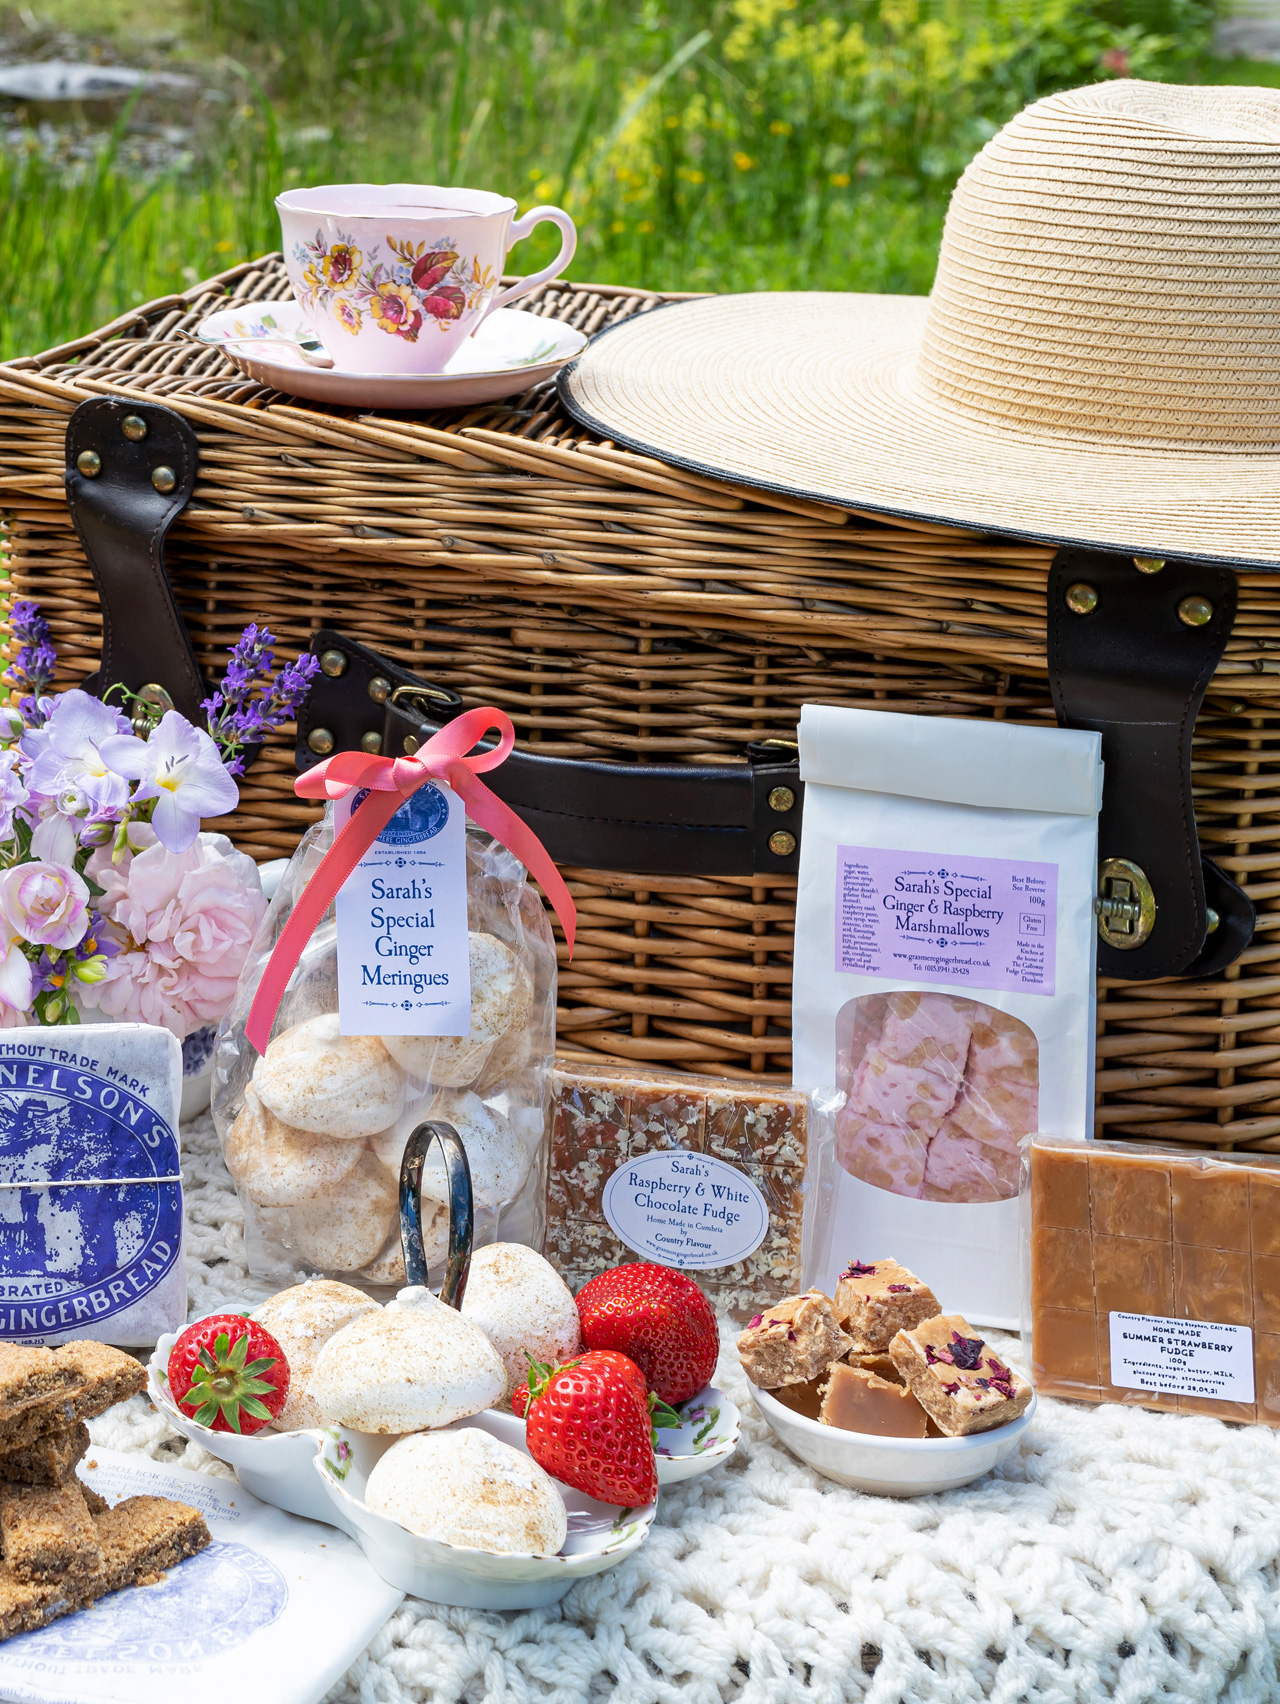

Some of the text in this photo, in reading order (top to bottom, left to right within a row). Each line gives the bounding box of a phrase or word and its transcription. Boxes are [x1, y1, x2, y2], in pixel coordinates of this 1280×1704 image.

[1012, 875, 1046, 885] Best Before:
[371, 878, 432, 900] Sarah's
[894, 876, 992, 902] Sarah's Special
[1025, 885, 1046, 893] Reverse
[1029, 896, 1045, 907] 100g
[883, 895, 1004, 924] Ginger & Raspberry
[371, 907, 435, 935] Special
[1023, 915, 1042, 924] Gluten
[895, 915, 990, 938] Marshmallows
[1026, 924, 1038, 932] Free
[375, 936, 434, 965] Ginger
[893, 953, 990, 967] www.grasmeregingerbread.co.uk
[1022, 962, 1044, 971] Galloway
[951, 967, 970, 975] 35428
[1006, 967, 1043, 978] Fudge Company
[361, 965, 449, 994] Meringues
[50, 1048, 99, 1071] TRADE
[106, 1066, 150, 1097] MARK
[671, 1160, 709, 1177] Sarah's
[628, 1172, 750, 1203] Raspberry & White
[634, 1193, 740, 1226] Chocolate Fudge
[647, 1214, 666, 1224] Home
[668, 1218, 686, 1228] Made
[696, 1222, 723, 1233] Cumbria
[680, 1228, 688, 1237] by
[655, 1233, 712, 1249] Country Flavour
[1153, 1326, 1175, 1334] HOME
[1123, 1332, 1233, 1353] SUMMER STRAWBERRY
[1161, 1346, 1195, 1357] FUDGE
[1169, 1358, 1186, 1366] 100g
[1188, 1368, 1212, 1376] butter,
[1214, 1371, 1235, 1379] MILK,
[1140, 1378, 1157, 1386] Best
[1160, 1382, 1184, 1390] before
[1182, 1376, 1225, 1386] strawberries
